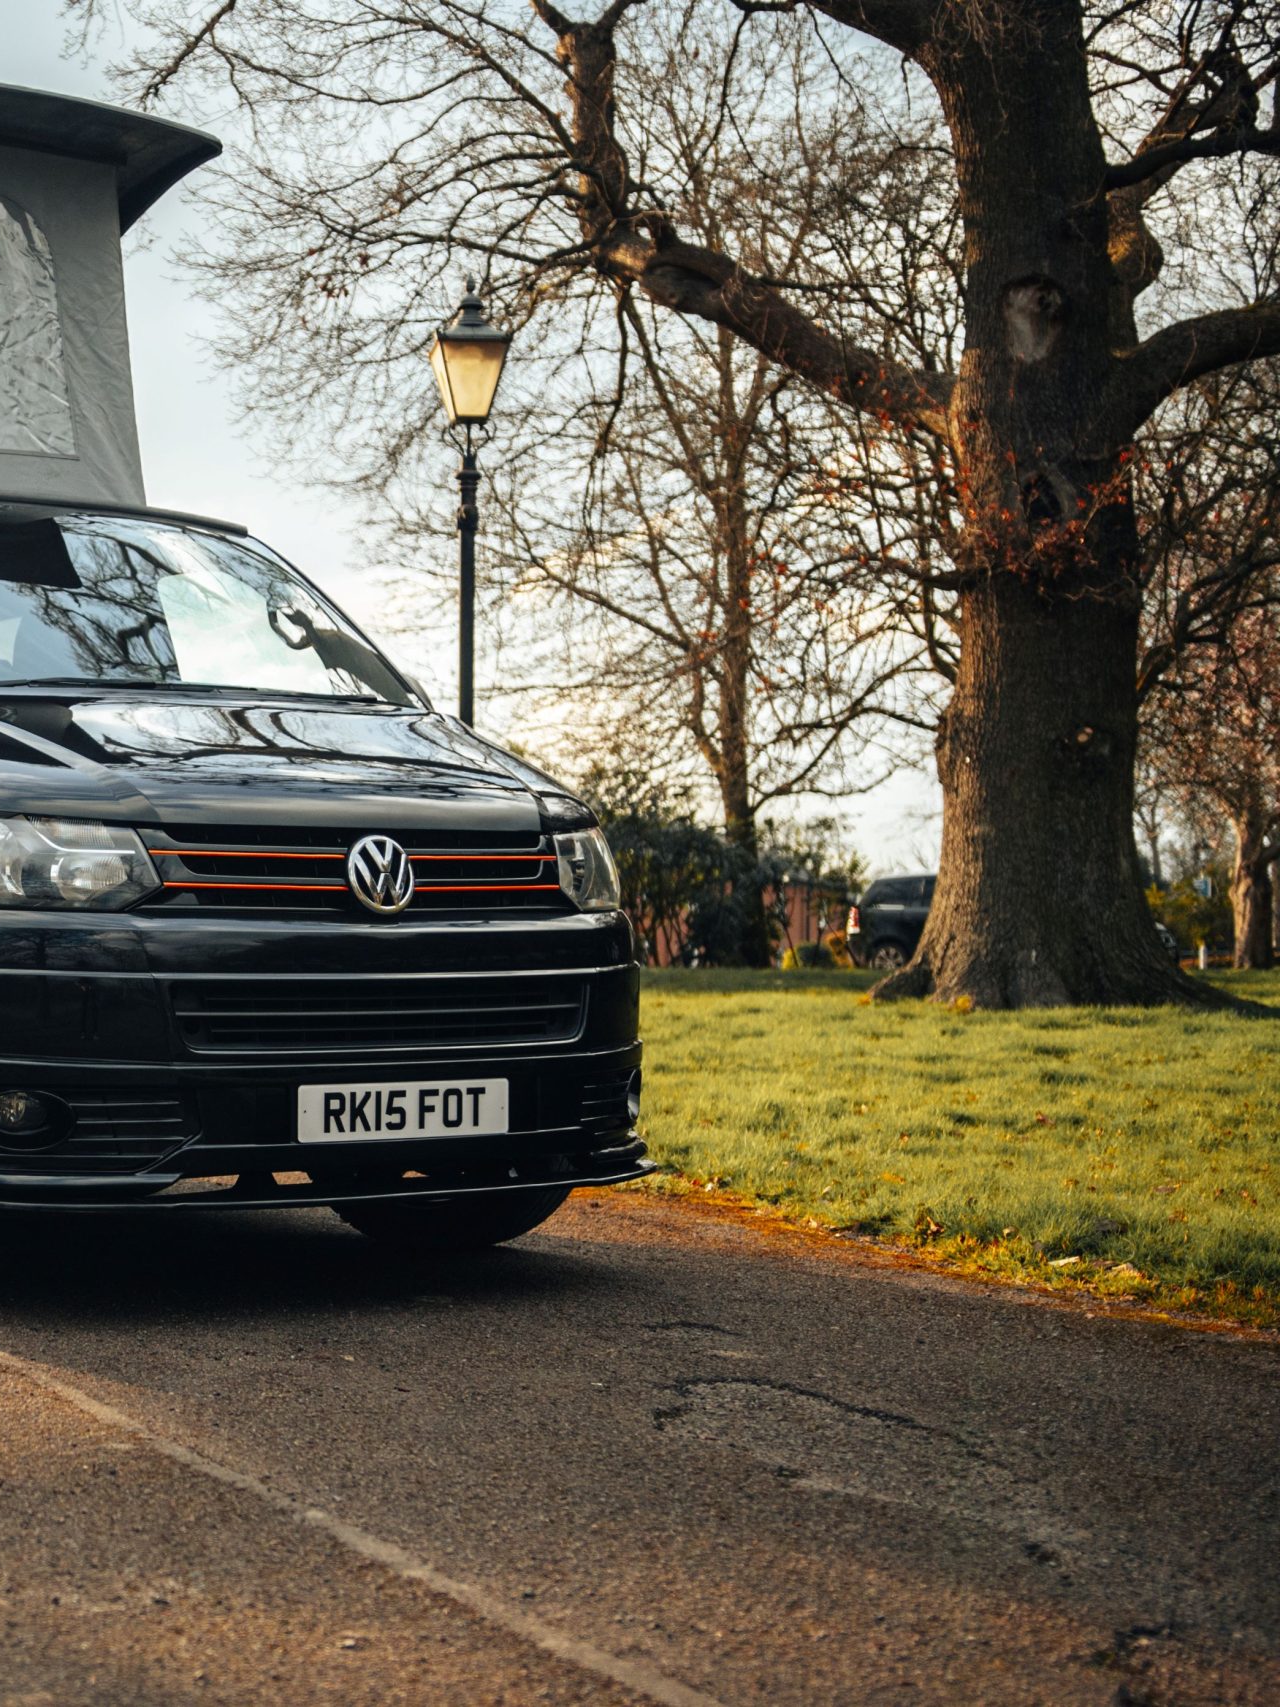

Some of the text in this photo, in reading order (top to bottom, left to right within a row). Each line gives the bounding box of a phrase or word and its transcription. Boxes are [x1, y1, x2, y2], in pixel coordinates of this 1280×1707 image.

[351, 837, 409, 909] VW
[323, 1087, 486, 1133] RK15 FOT
